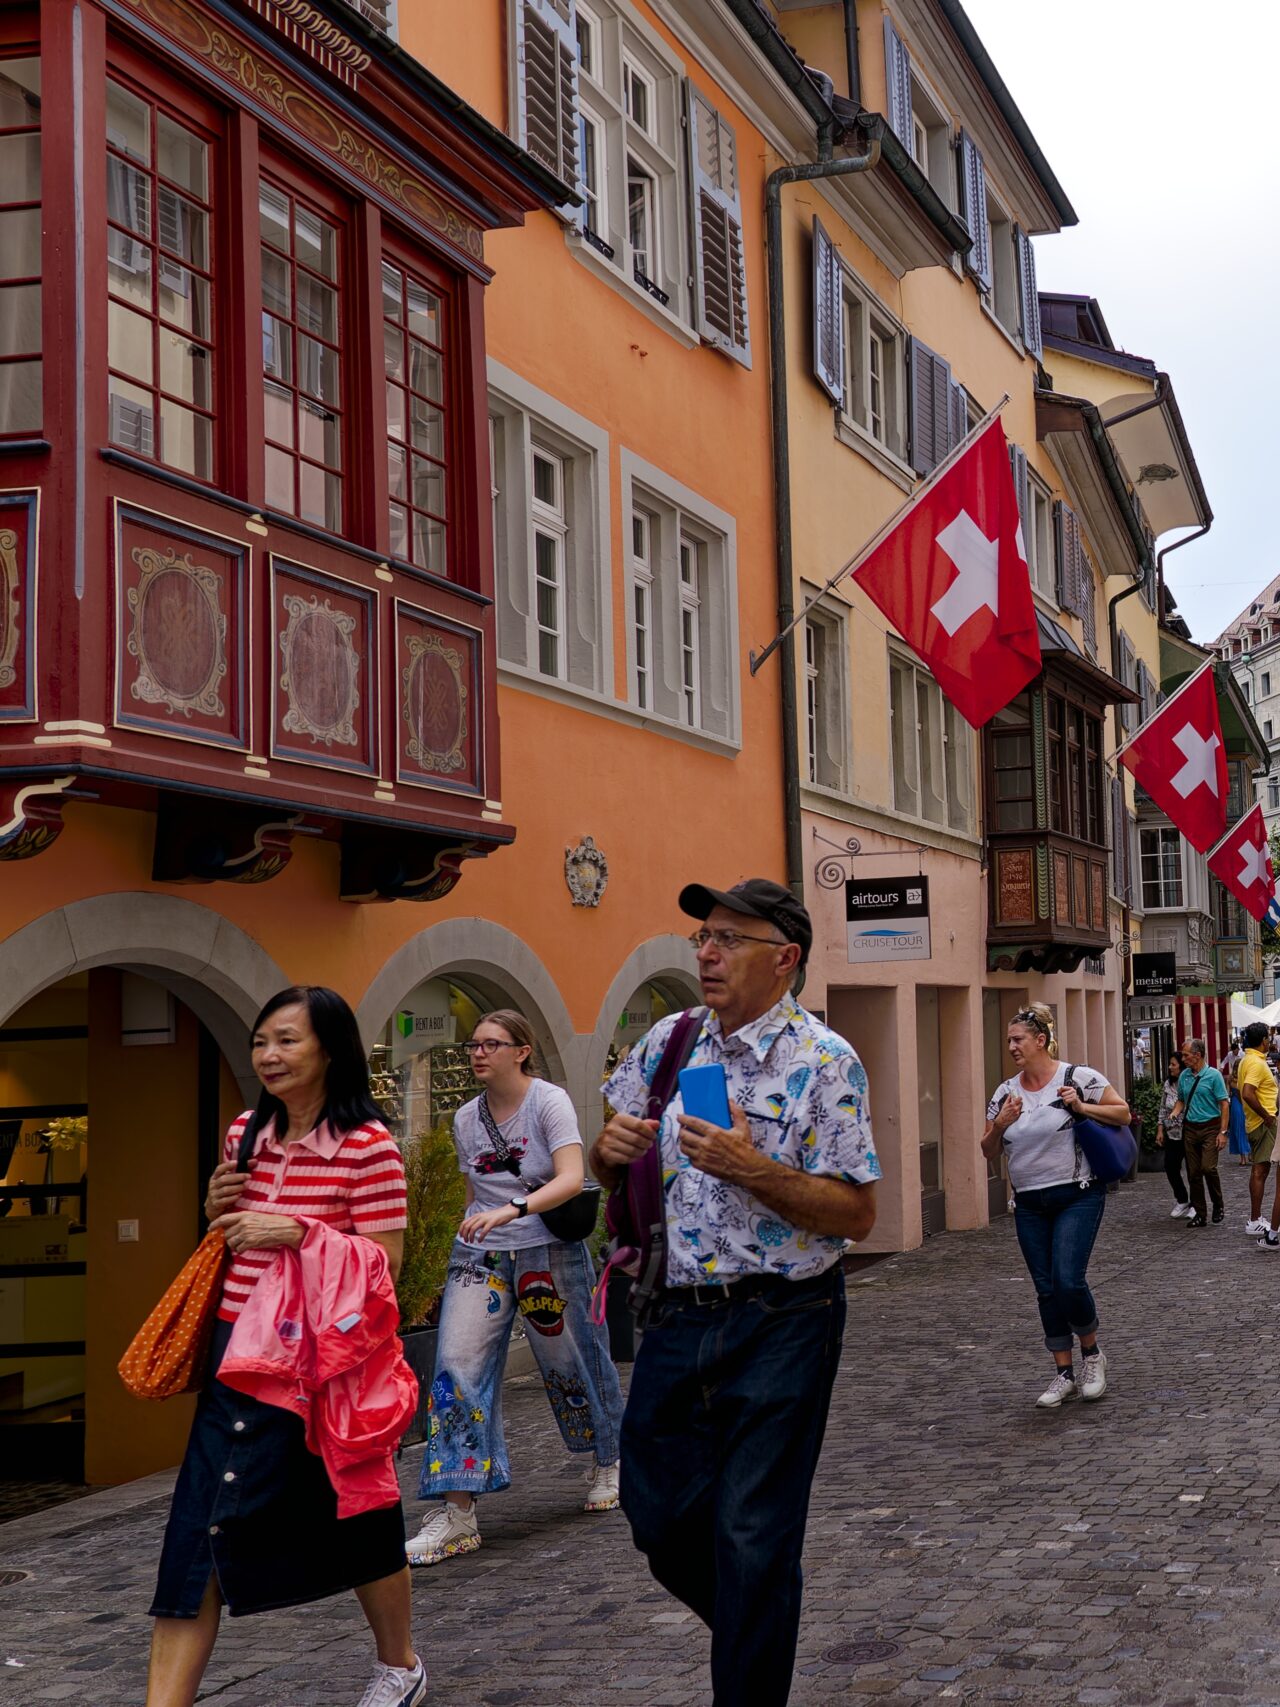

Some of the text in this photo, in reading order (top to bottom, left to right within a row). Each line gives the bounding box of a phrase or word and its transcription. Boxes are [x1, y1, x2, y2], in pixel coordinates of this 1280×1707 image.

[852, 892, 899, 905] airtours
[853, 935, 924, 949] CRUISETOUR
[1135, 977, 1174, 986] meister
[415, 1017, 429, 1030] RENT
[433, 1016, 444, 1029] BOX
